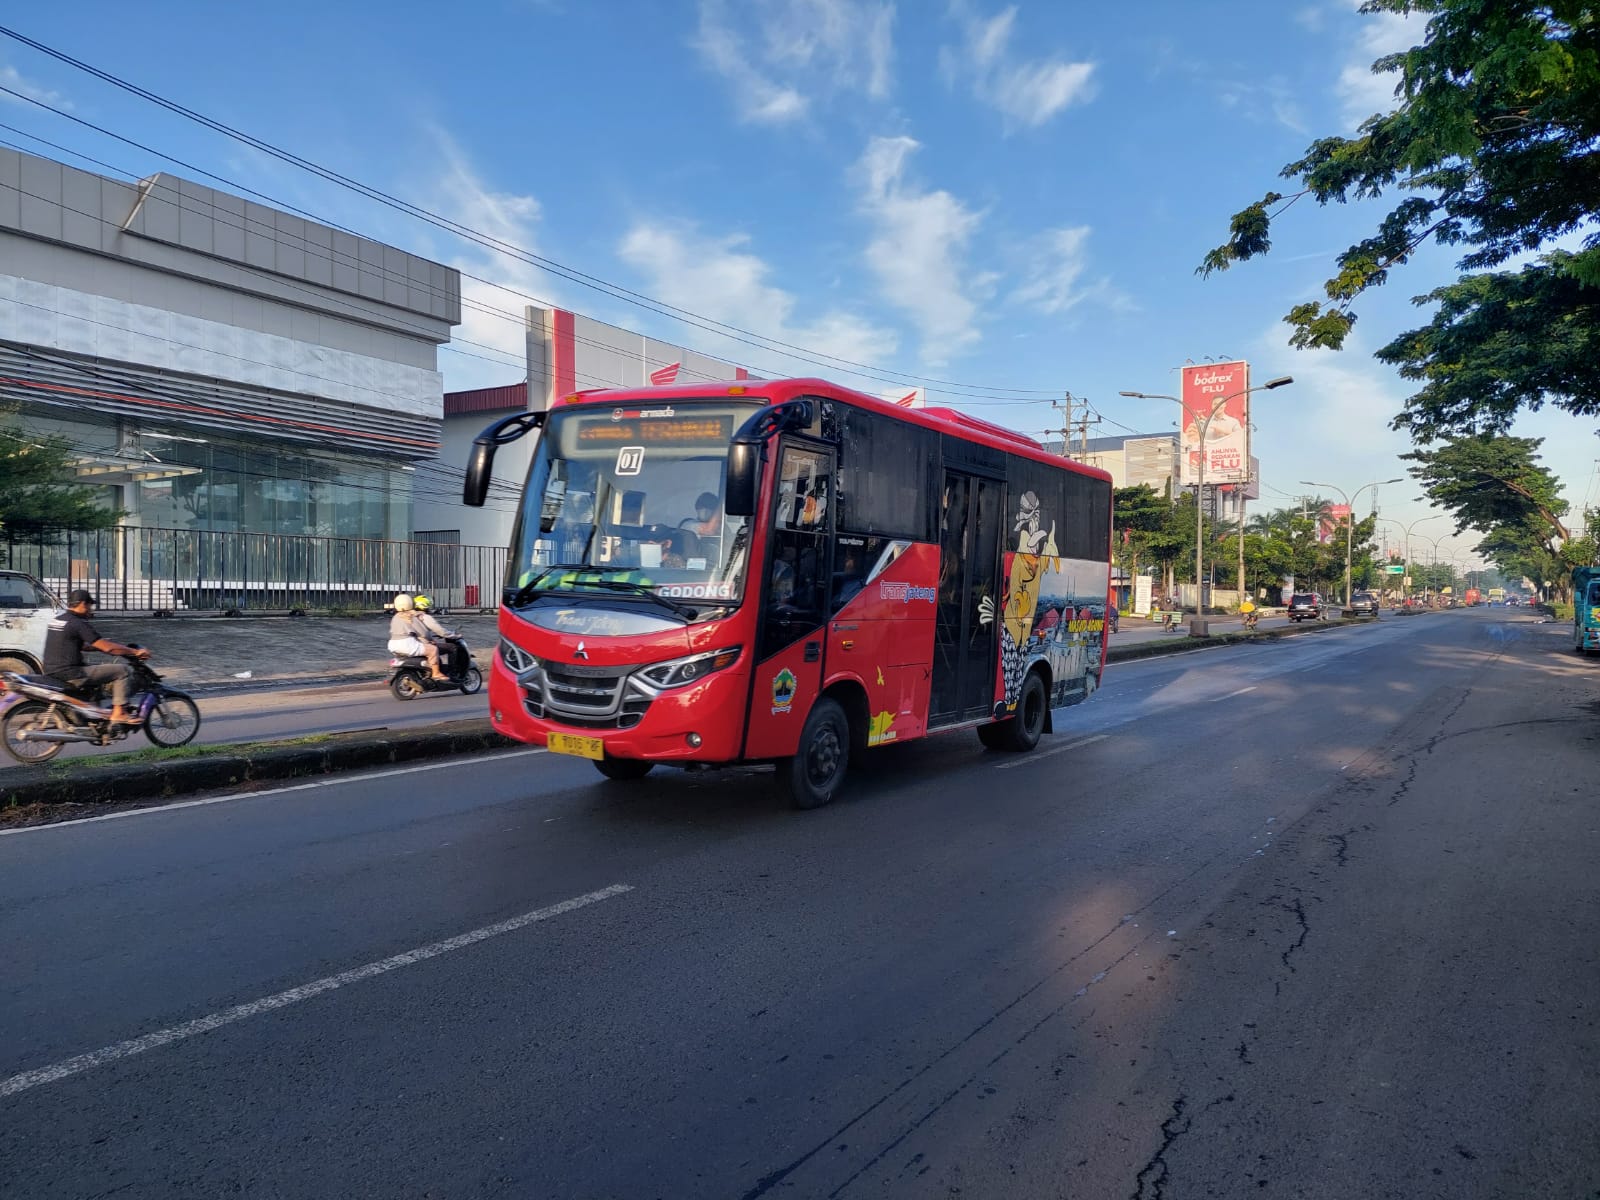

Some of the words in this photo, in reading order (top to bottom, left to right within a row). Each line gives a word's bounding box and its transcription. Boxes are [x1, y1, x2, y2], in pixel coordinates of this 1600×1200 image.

[1194, 372, 1233, 386] bodrex
[1202, 385, 1225, 393] FLU
[620, 452, 640, 469] 01
[1211, 459, 1240, 469] FLU
[658, 586, 729, 598] GODONG
